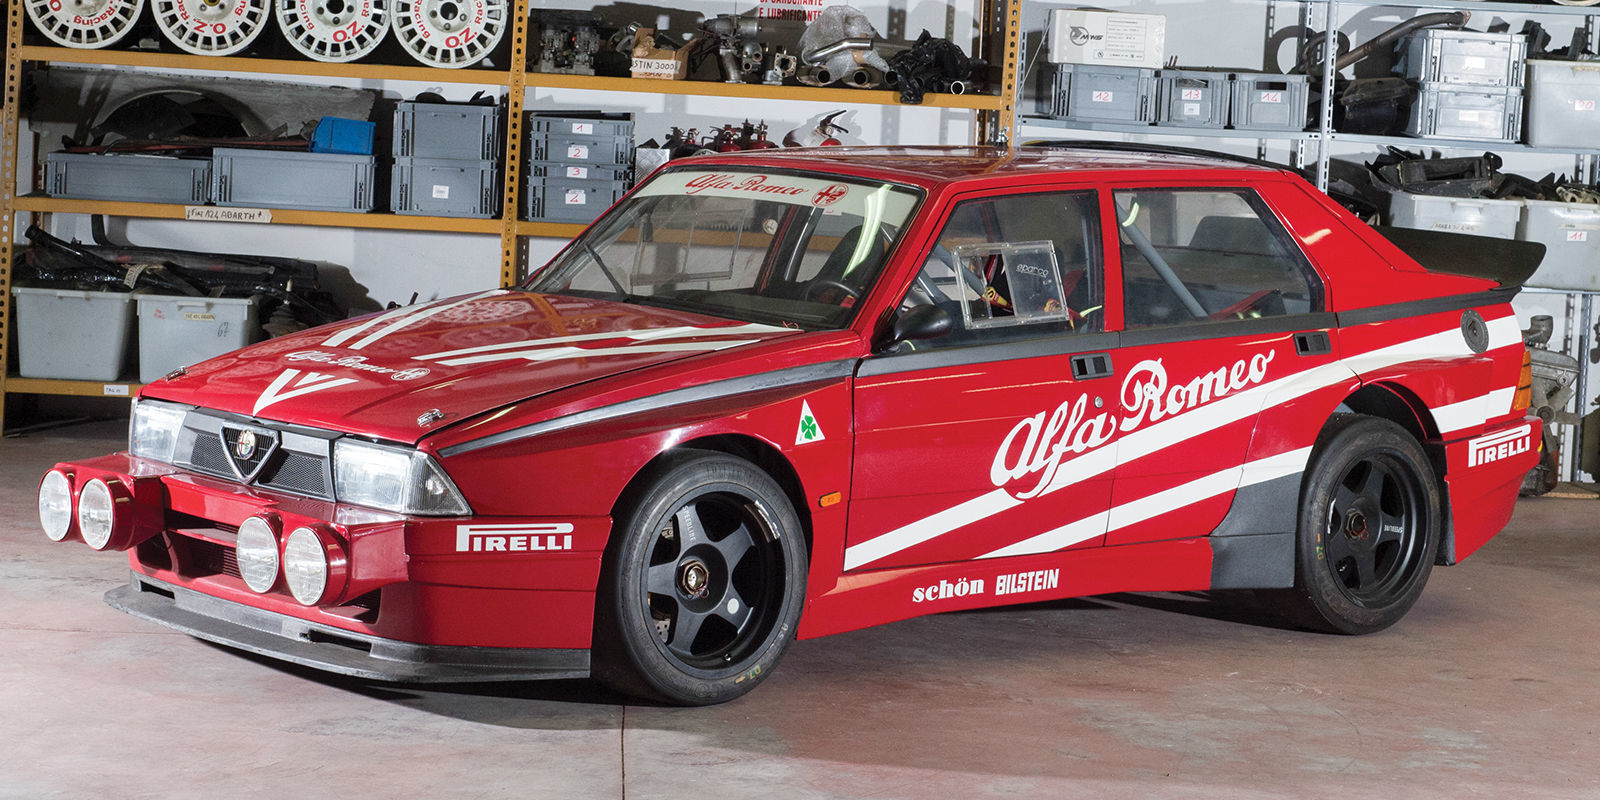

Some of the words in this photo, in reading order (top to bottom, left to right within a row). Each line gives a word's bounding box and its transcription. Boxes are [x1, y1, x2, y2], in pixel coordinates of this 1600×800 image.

[73, 6, 116, 26] Racing
[759, 7, 764, 19] E
[1094, 91, 1110, 101] 12
[1184, 89, 1200, 99] 13
[1262, 92, 1279, 102] 14
[576, 124, 584, 132] 1
[573, 148, 581, 158] 2
[571, 167, 581, 176] 3
[685, 174, 734, 195] Alfa
[733, 175, 808, 195] Romeo
[1016, 263, 1049, 278] sparco
[990, 393, 1117, 499] Alfa
[1119, 349, 1276, 431] Romeo
[1467, 423, 1532, 468] PIRELLI
[456, 522, 574, 552] PIRELLI
[912, 577, 985, 603] schön
[995, 568, 1060, 596] BILSTEIN
